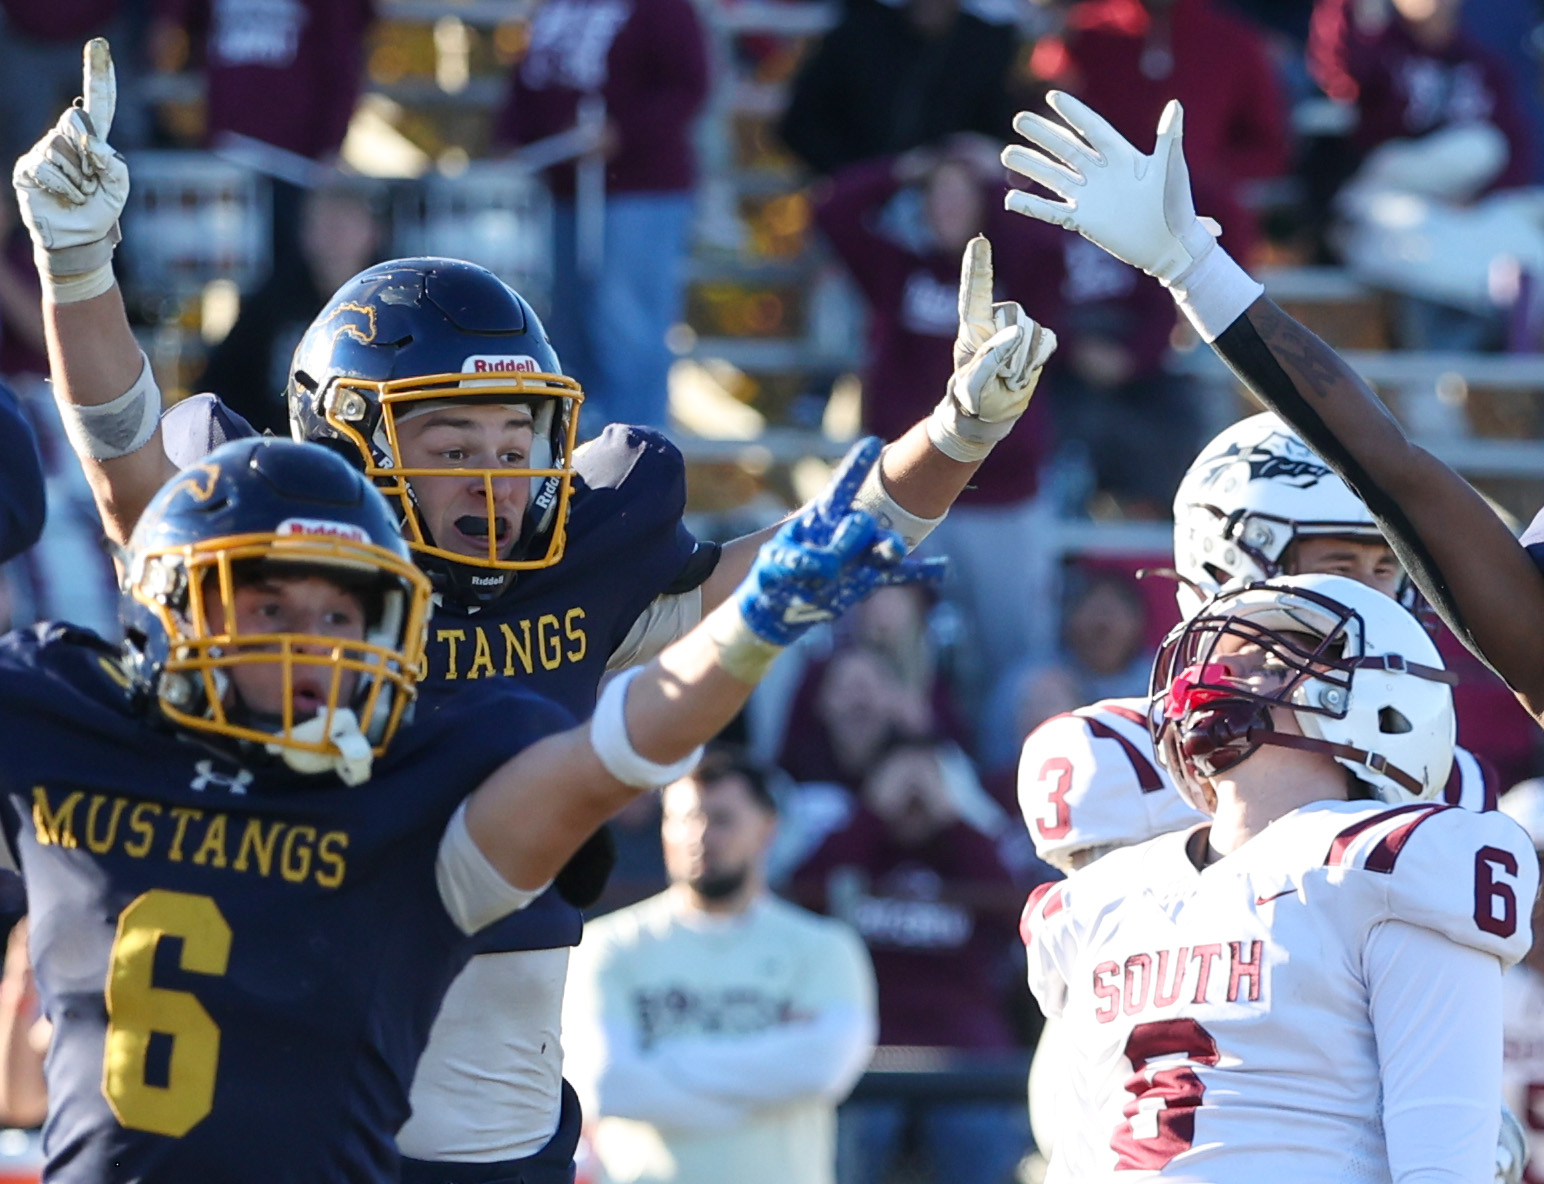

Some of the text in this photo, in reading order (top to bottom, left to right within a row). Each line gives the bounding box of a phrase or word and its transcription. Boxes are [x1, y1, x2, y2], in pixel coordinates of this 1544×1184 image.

[473, 358, 536, 373] Riddell
[471, 575, 505, 586] Riddell
[31, 785, 351, 889] MUSTANGS
[1035, 756, 1075, 841] 3
[1473, 846, 1519, 939] 6
[101, 888, 234, 1139] 6
[1093, 938, 1265, 1024] SOUTH
